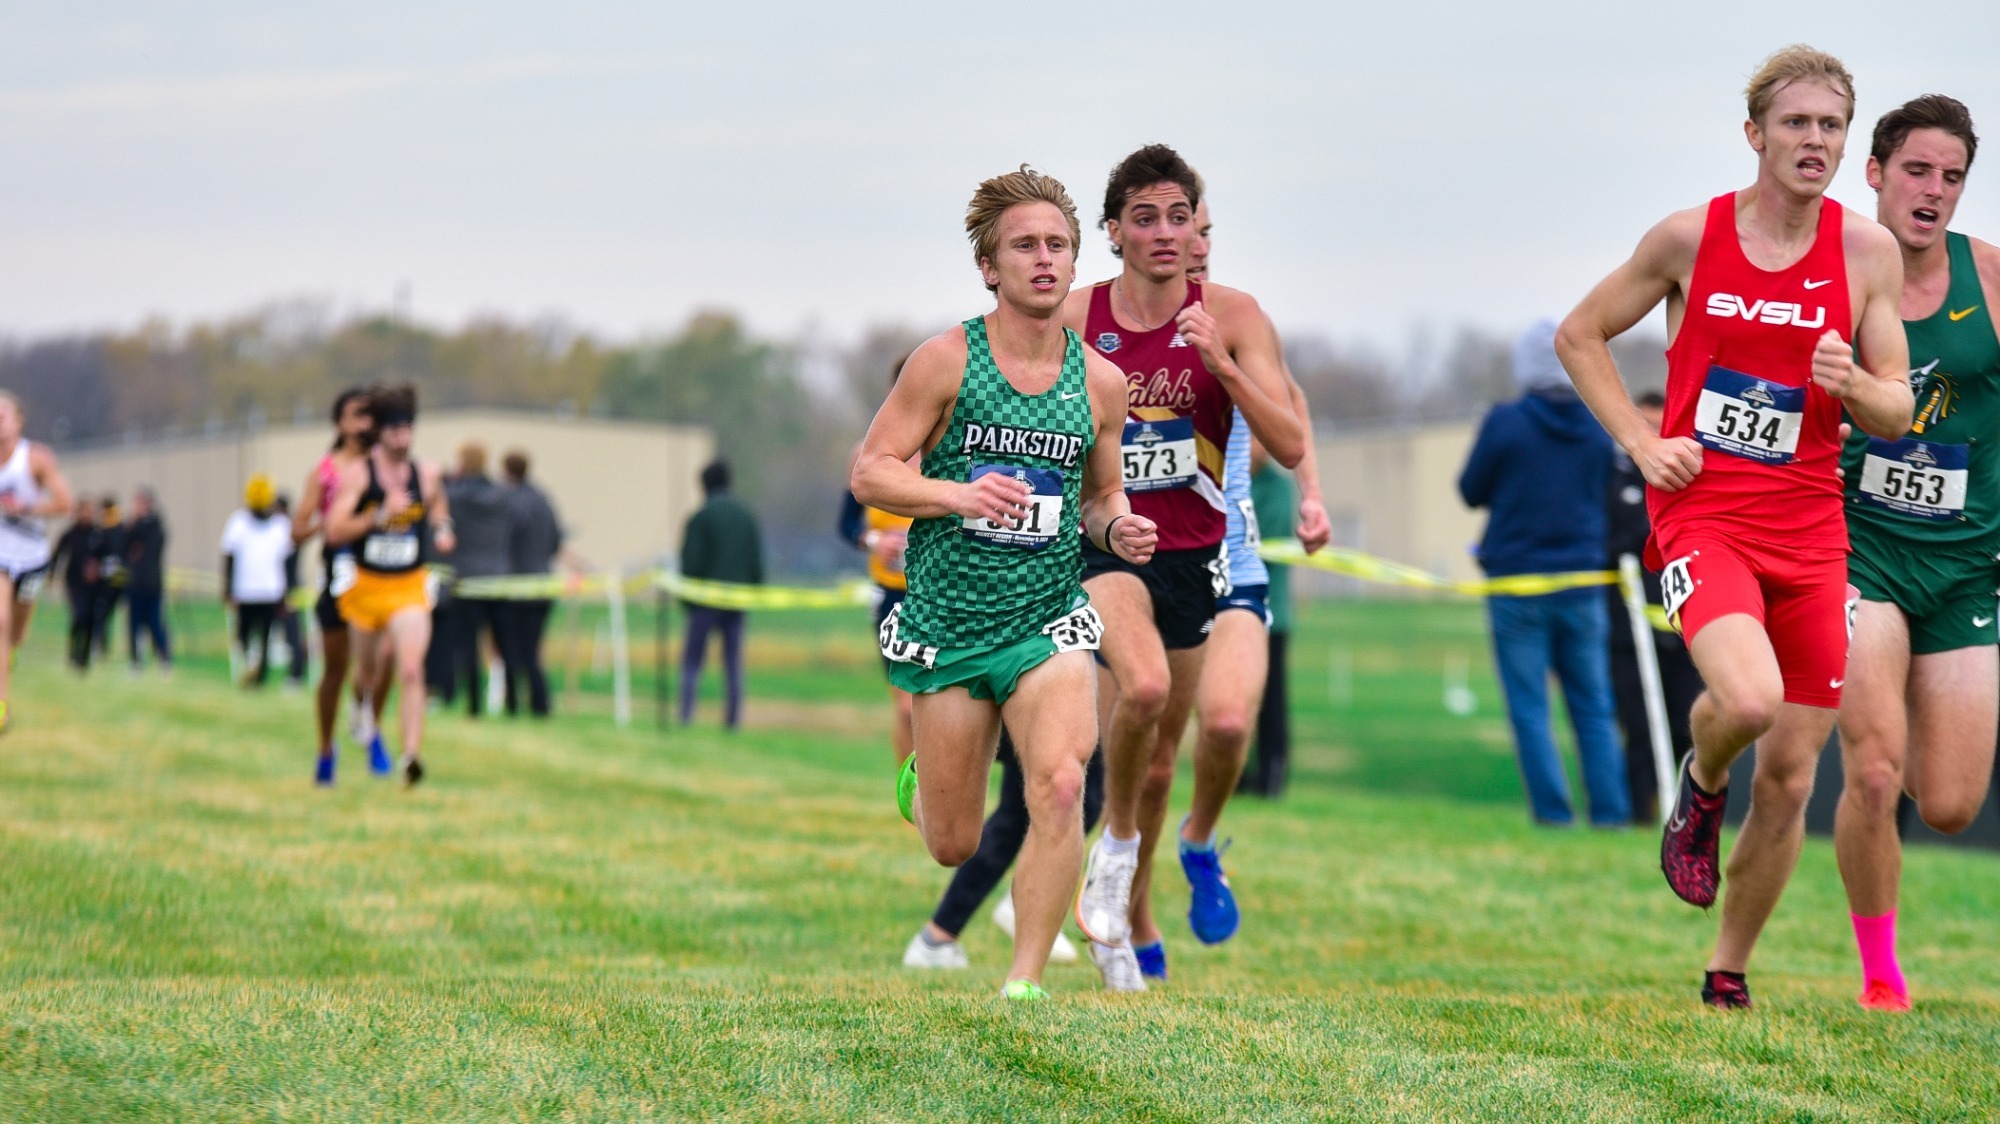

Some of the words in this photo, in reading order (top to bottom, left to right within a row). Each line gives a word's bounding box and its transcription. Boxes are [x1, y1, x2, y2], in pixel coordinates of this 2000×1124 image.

[1706, 292, 1826, 328] SVSU
[963, 423, 1083, 467] PARKSIDE
[1717, 403, 1782, 448] 534
[1123, 448, 1178, 480] 573
[1883, 466, 1945, 505] 553
